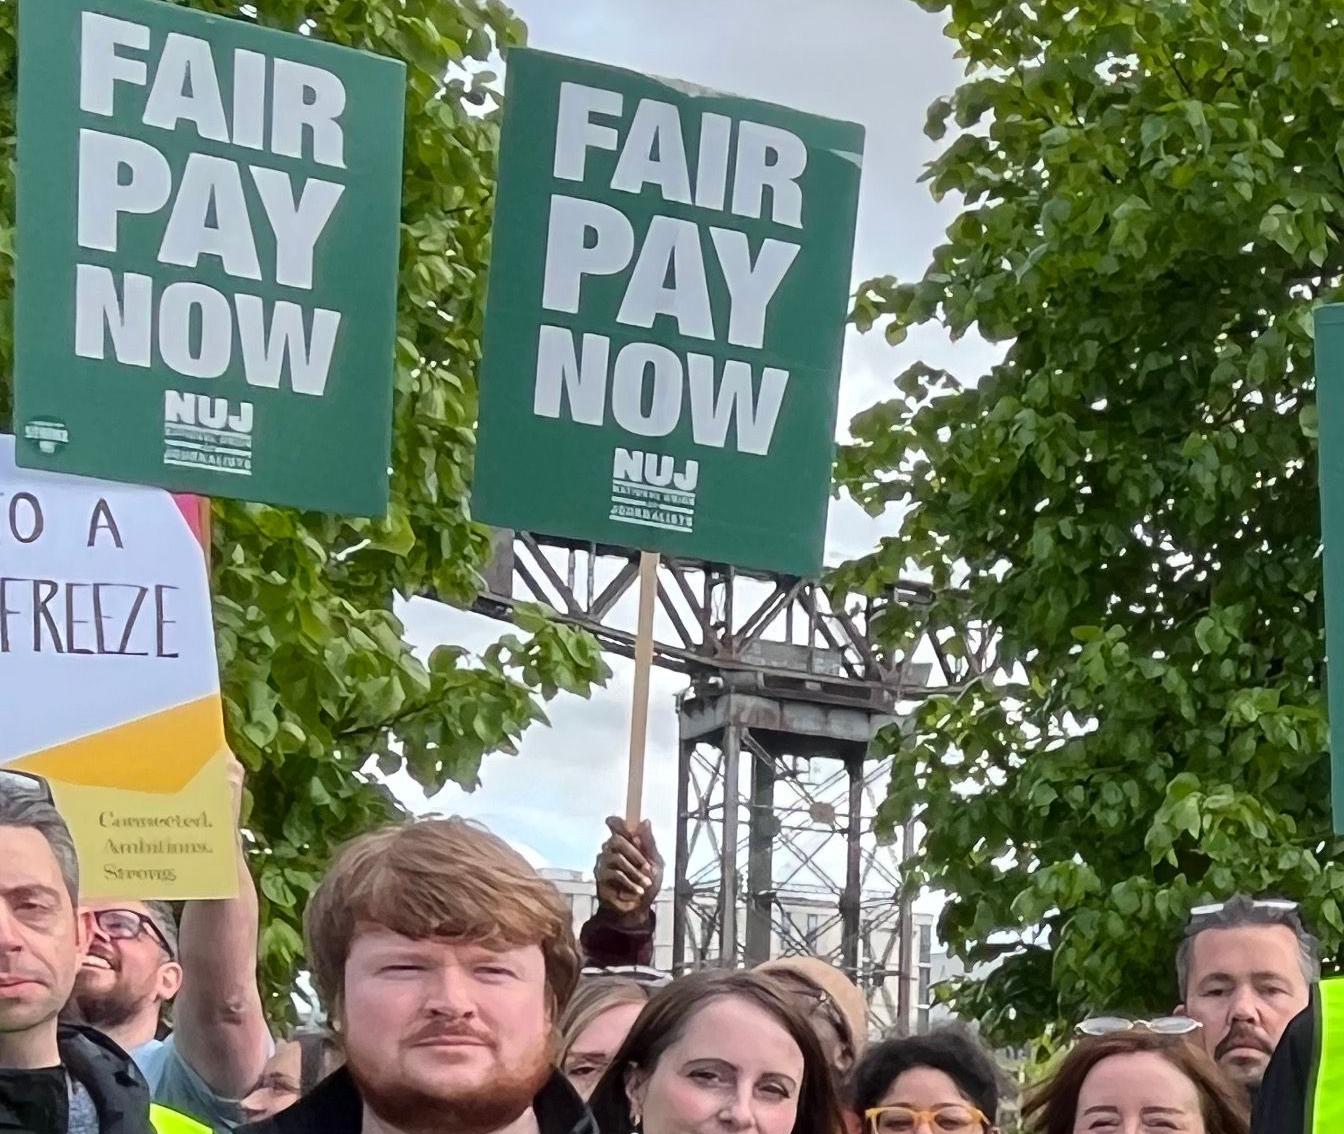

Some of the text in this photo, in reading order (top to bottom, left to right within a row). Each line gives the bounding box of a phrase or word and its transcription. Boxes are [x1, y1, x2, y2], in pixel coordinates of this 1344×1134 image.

[80, 11, 347, 168] FAIR
[554, 82, 807, 228] FAIR
[78, 128, 345, 289] PAY
[543, 195, 800, 348] PAY
[75, 264, 343, 396] NOW
[534, 325, 789, 456] NOW
[164, 389, 253, 433] NUJ
[613, 448, 699, 491] NUJ
[0, 492, 123, 548] O A
